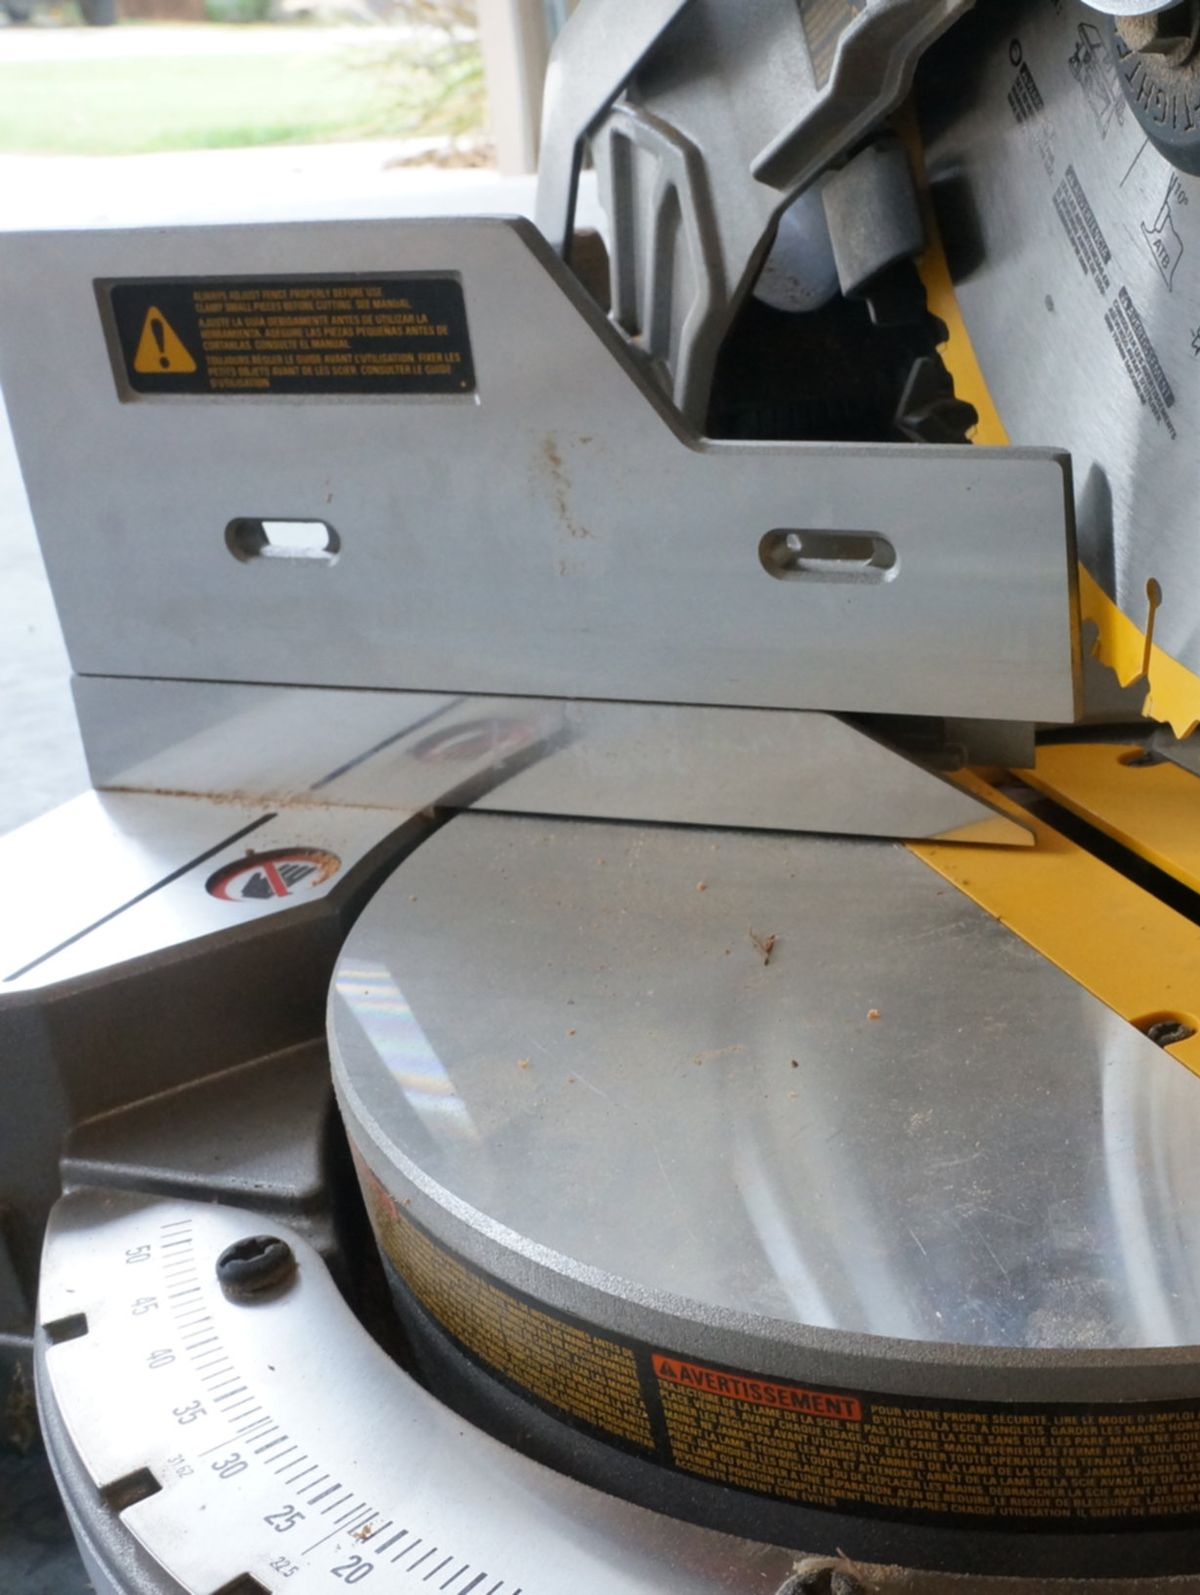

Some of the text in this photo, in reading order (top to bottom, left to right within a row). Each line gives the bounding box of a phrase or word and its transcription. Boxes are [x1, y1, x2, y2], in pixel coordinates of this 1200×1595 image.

[1153, 239, 1170, 269] ATB
[126, 1244, 151, 1265] 50
[131, 1296, 159, 1316] 45
[146, 1348, 176, 1369] 40
[680, 1366, 856, 1418] AVERTISSEMENT
[172, 1400, 207, 1426] 35
[212, 1453, 248, 1480] 30
[263, 1504, 306, 1533] 25
[330, 1555, 374, 1585] 20
